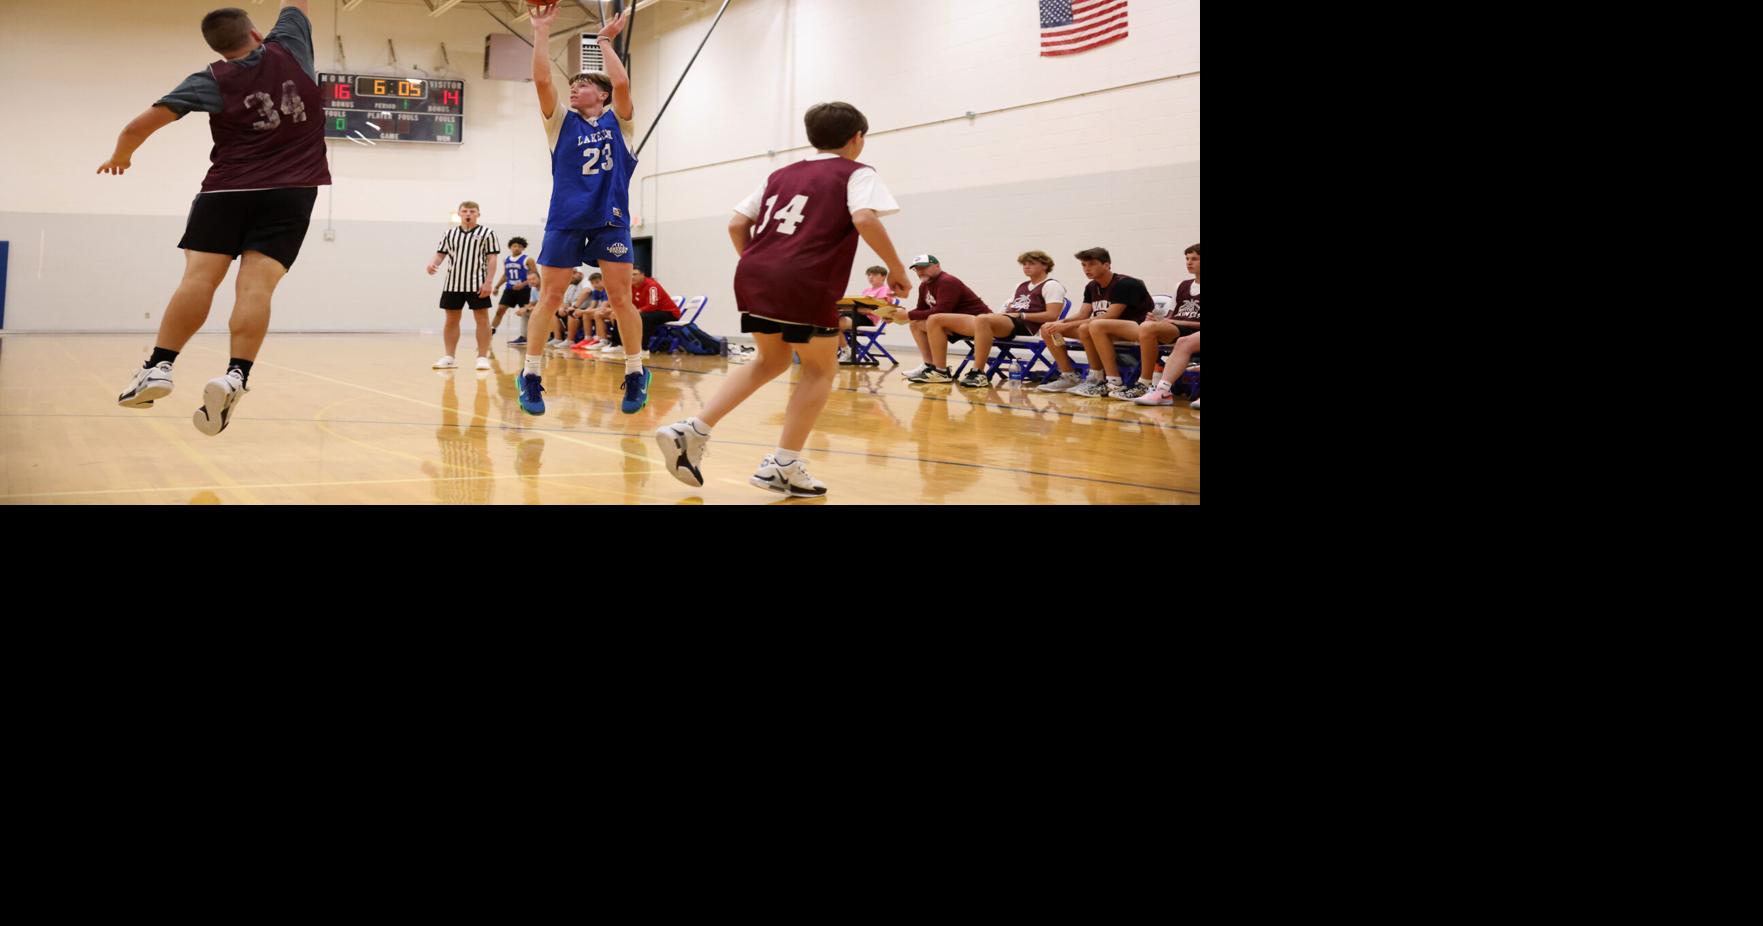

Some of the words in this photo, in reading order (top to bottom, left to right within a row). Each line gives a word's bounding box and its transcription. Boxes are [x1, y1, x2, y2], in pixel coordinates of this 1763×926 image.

[321, 74, 353, 83] HOME
[430, 81, 462, 89] VISITOR
[335, 83, 351, 99] 16
[443, 90, 459, 105] 14
[244, 80, 307, 130] 34
[582, 143, 613, 175] 23
[750, 194, 809, 239] 14
[509, 268, 518, 279] 11
